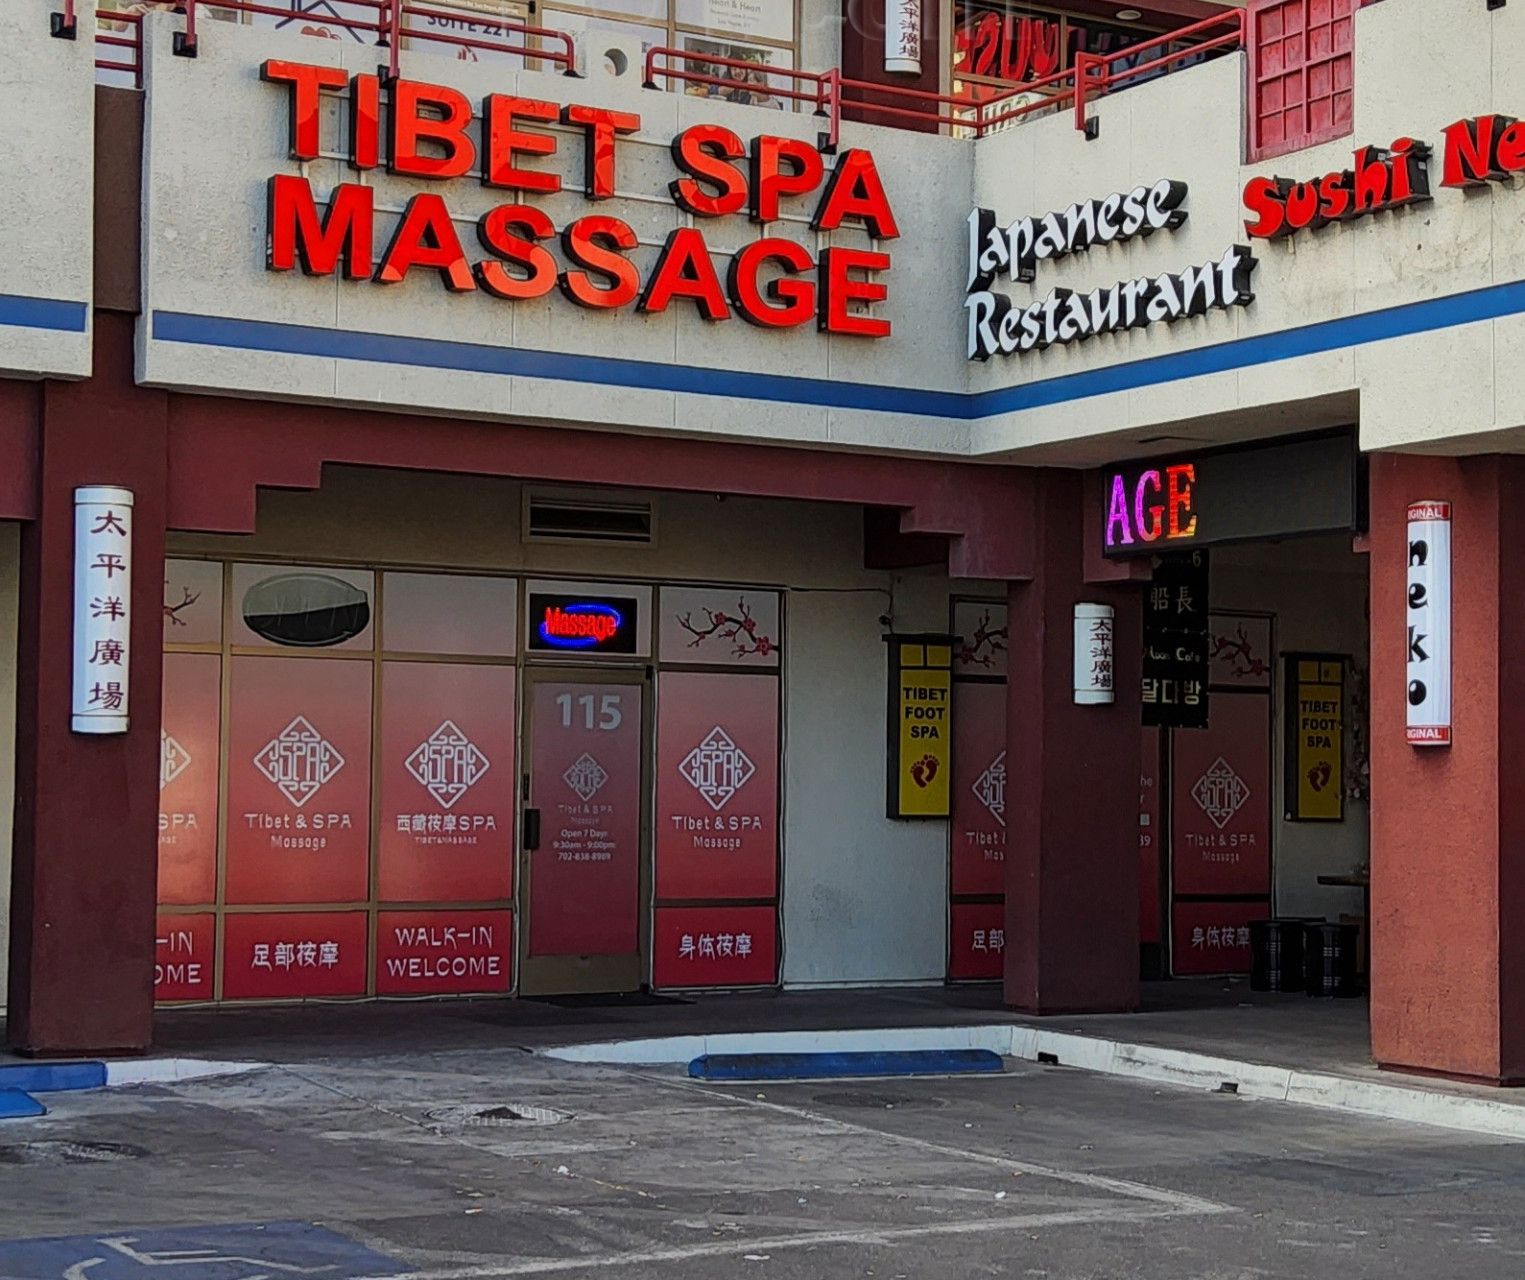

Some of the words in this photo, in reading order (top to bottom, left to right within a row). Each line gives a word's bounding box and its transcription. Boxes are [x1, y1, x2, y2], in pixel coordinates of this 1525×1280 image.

[261, 59, 641, 200] TIBET
[671, 124, 901, 239] SPA
[1243, 137, 1426, 240] Sushi
[967, 178, 1180, 290] Japanese
[266, 174, 892, 338] MASSAGE
[963, 245, 1250, 361] Restaurant
[1106, 464, 1197, 546] AGE
[88, 510, 127, 710] 太平洋廣場
[544, 606, 617, 641] Massage
[1089, 619, 1112, 688] 太平洋廣場
[903, 687, 948, 701] TIBET
[1141, 678, 1201, 705] 달다방
[556, 693, 622, 730] 115
[904, 707, 945, 720] FOOT
[1300, 700, 1338, 713] TIBET
[910, 725, 940, 739] SPA
[1302, 718, 1336, 731] FOOT
[1306, 736, 1332, 748] SPA
[158, 813, 198, 830] SPA
[244, 813, 290, 829] Tibet
[295, 814, 308, 829] &
[312, 814, 352, 829] SPA
[672, 816, 710, 831] Tibet
[715, 816, 725, 830] &
[729, 816, 762, 830] SPA
[693, 836, 741, 851] Massage
[1229, 834, 1257, 846] SPA
[394, 926, 494, 950] WALK-IN
[678, 933, 752, 961] 身体按摩
[252, 940, 339, 971] 足部按摩
[386, 956, 501, 977] WELCOME
